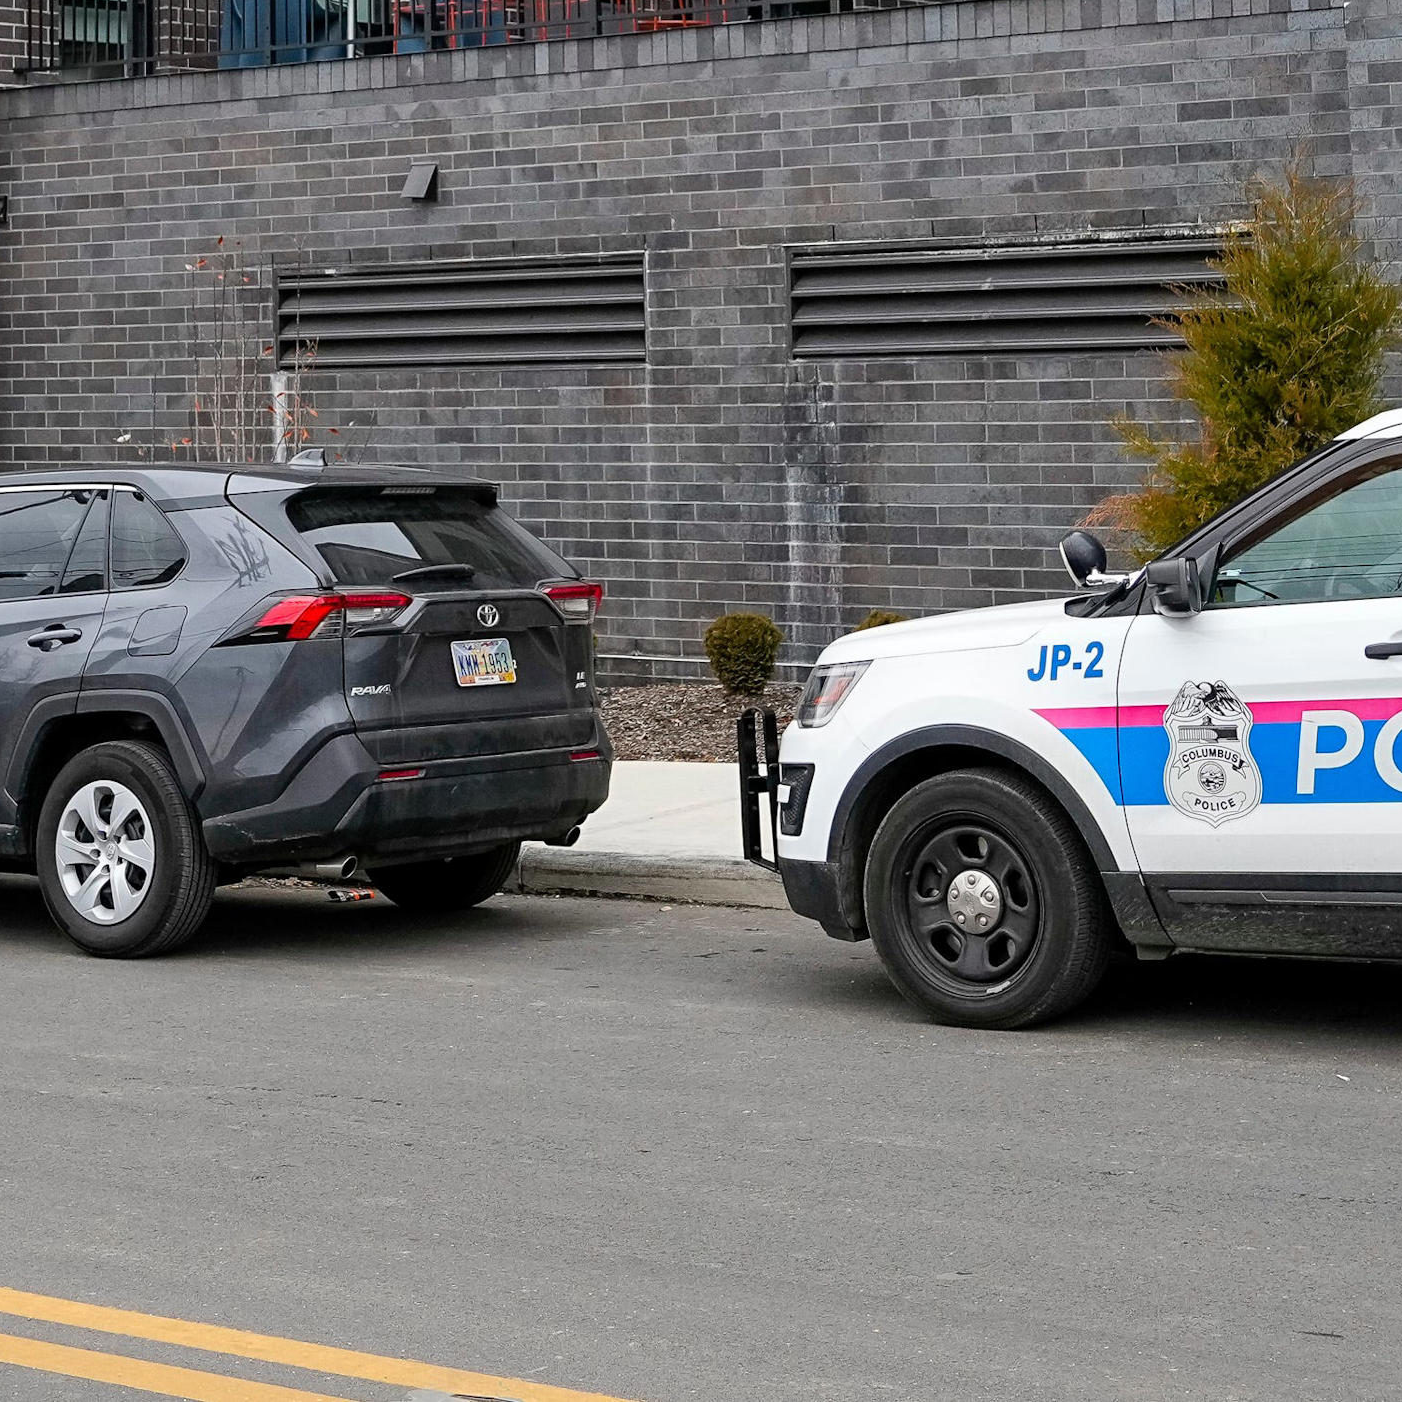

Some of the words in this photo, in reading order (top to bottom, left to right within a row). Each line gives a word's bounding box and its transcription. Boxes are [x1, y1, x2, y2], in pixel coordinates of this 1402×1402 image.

[1027, 640, 1105, 682] JP-2
[350, 683, 392, 697] RAV4
[1182, 748, 1239, 763] COLUMBUS
[1194, 797, 1236, 812] POLICE
